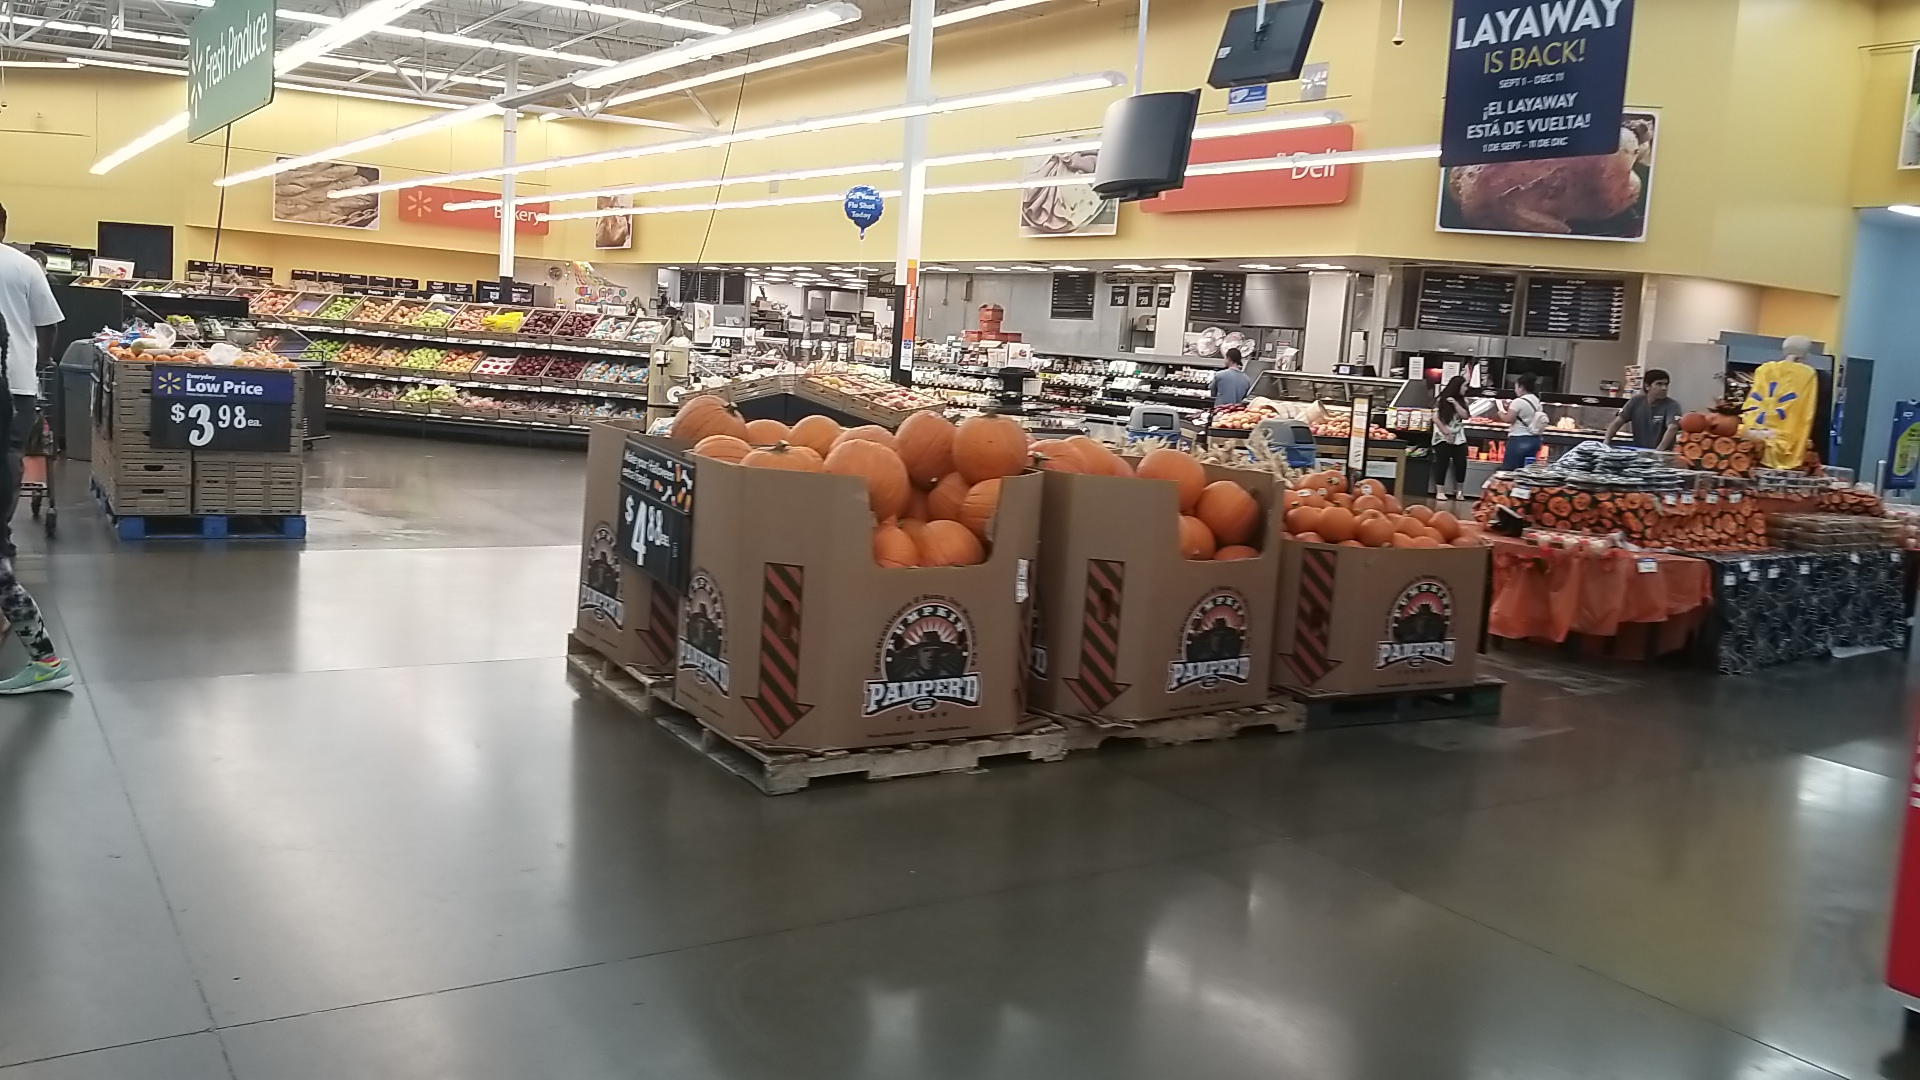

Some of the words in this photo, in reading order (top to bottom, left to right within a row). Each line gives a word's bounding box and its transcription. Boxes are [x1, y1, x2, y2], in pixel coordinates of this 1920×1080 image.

[1455, 0, 1622, 50] LAYAWAY
[205, 44, 226, 90] Fresh
[227, 9, 268, 75] Produce
[1483, 51, 1504, 74] IS
[1509, 38, 1587, 71] BACK!
[1498, 77, 1522, 89] SEPT
[1533, 73, 1555, 85] DEC
[1507, 92, 1579, 114] LAYAWAY
[1466, 118, 1501, 139] ESTÁ
[1503, 119, 1526, 136] DE
[1527, 113, 1592, 134] VUELTA!
[494, 206, 541, 226] Bkery
[186, 379, 221, 393] Low
[223, 380, 264, 396] Price
